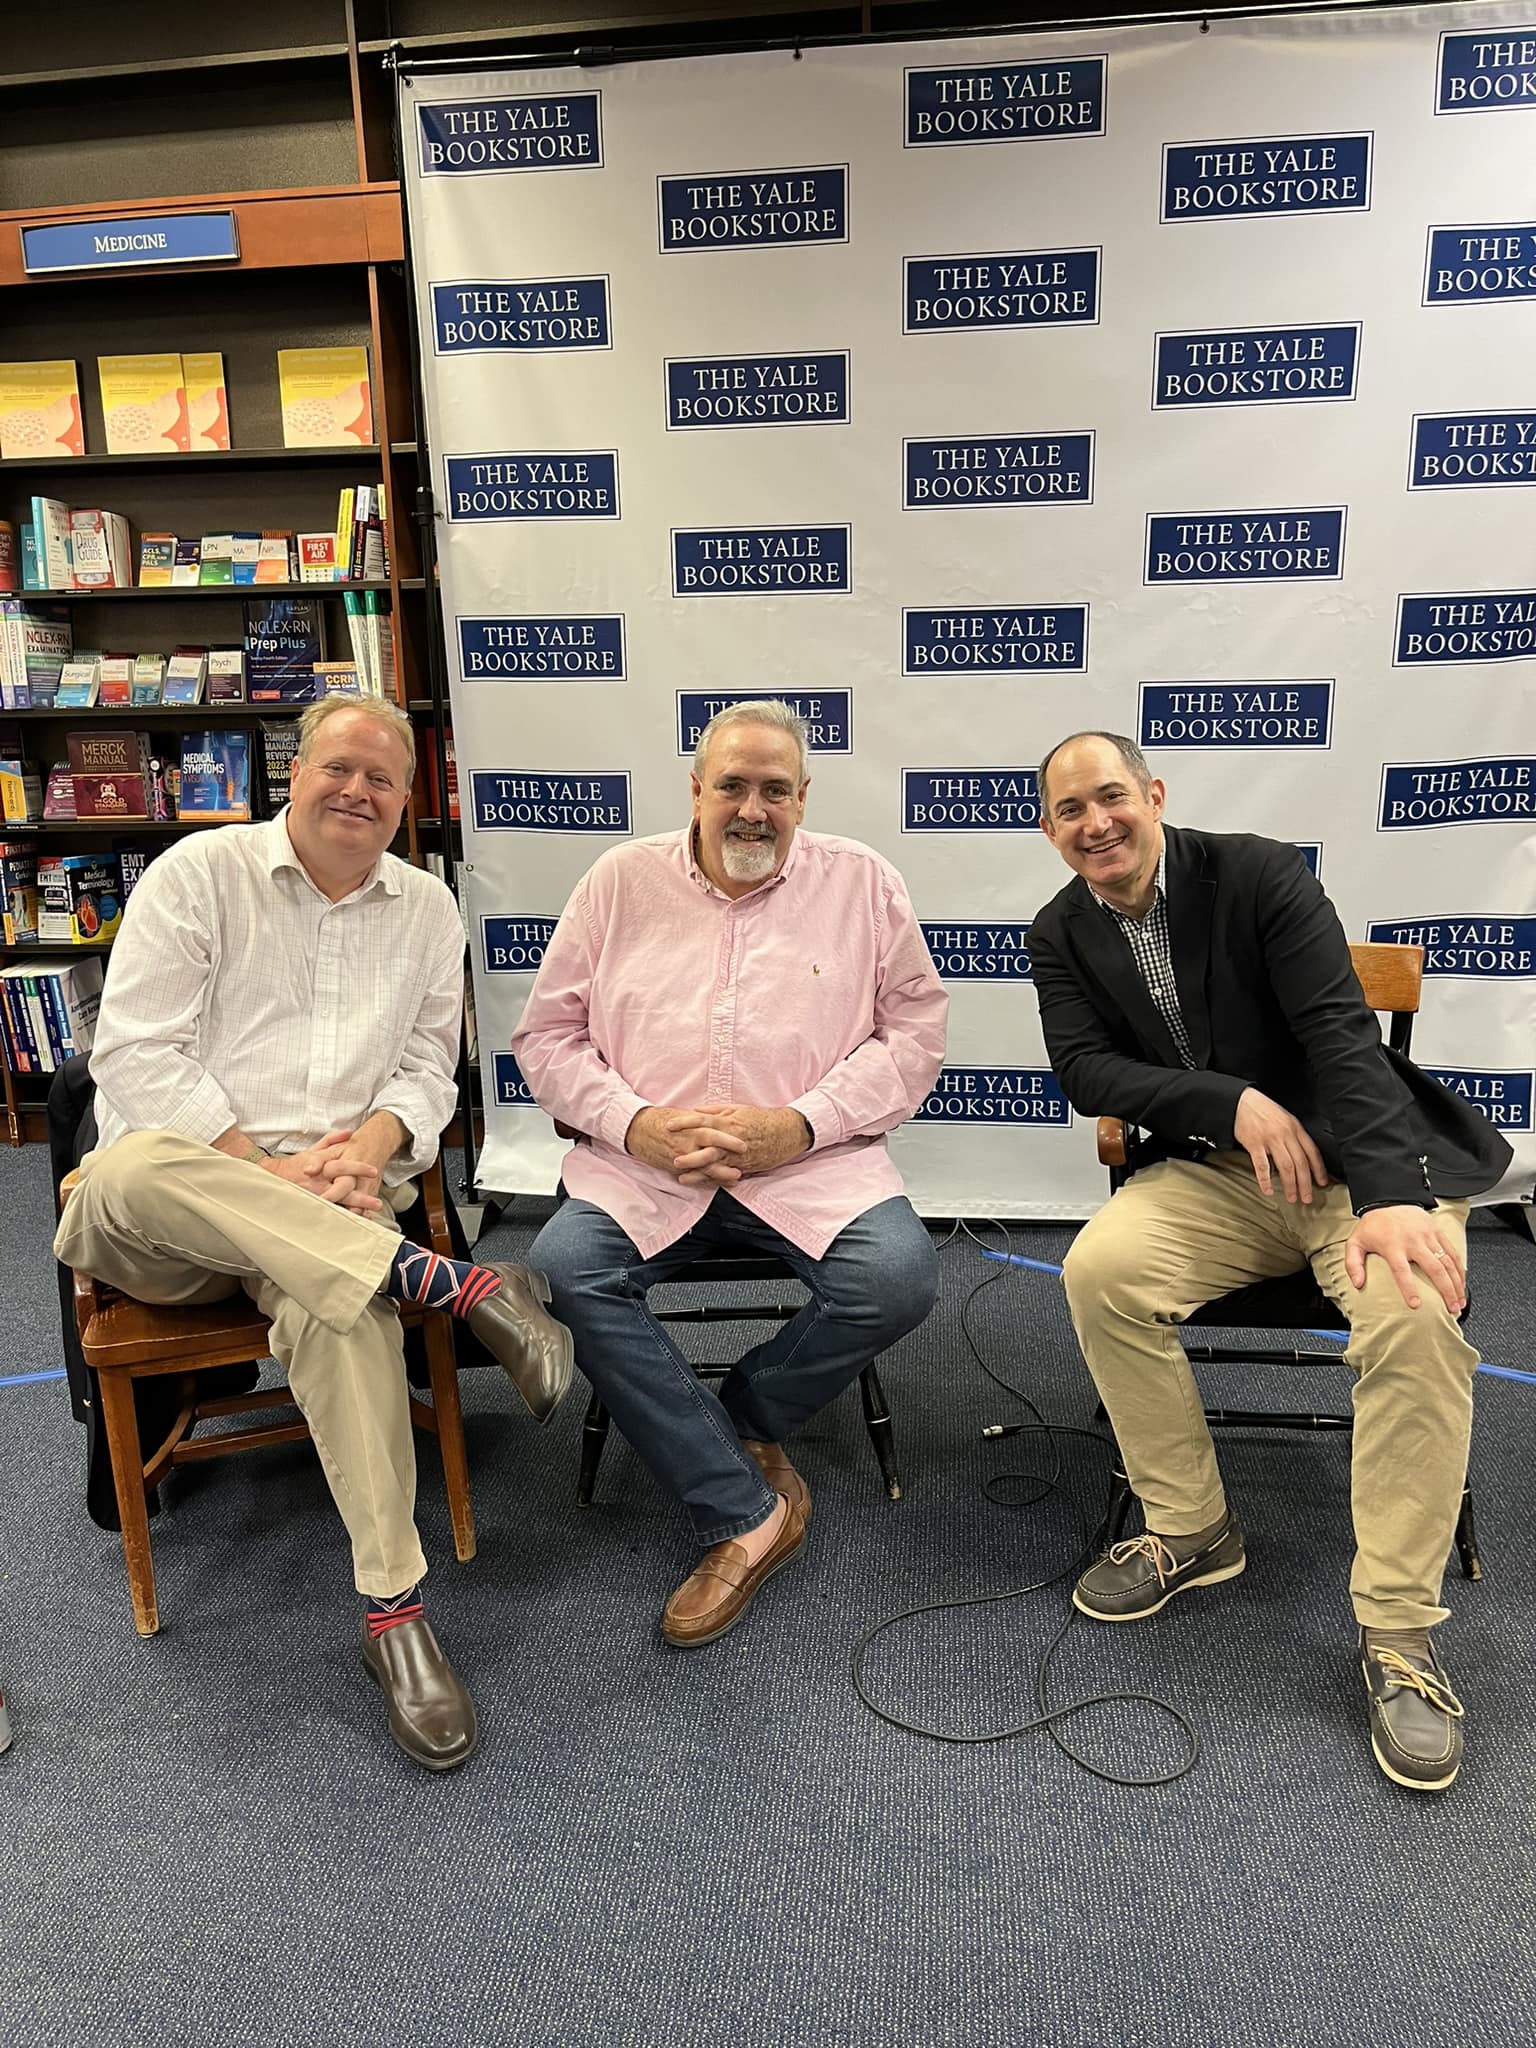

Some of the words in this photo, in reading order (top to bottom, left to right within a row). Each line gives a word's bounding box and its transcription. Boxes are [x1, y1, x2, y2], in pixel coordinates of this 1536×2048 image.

[1472, 41, 1536, 68] THE
[935, 77, 994, 103] THE
[1002, 71, 1072, 99] YALE
[444, 110, 498, 135] THE
[505, 105, 570, 131] YALE
[917, 101, 1093, 134] BOOKSTORE
[429, 134, 591, 166] BOOKSTORE
[1195, 152, 1256, 178] THE
[1264, 147, 1337, 174] YALE
[687, 185, 743, 210] THE
[750, 180, 816, 206] YALE
[1173, 176, 1358, 210] BOOKSTORE
[671, 209, 837, 241] BOOKSTORE
[94, 233, 168, 253] MEDICINE
[1459, 237, 1521, 262] THE
[934, 266, 991, 291] THE
[999, 262, 1067, 287] YALE
[456, 292, 509, 315] THE
[516, 289, 580, 313] YALE
[915, 291, 1088, 321] BOOKSTORE
[444, 317, 601, 344] BOOKSTORE
[1186, 342, 1246, 367] THE
[1254, 337, 1325, 363] YALE
[693, 368, 747, 391] THE
[754, 365, 818, 388] YALE
[1165, 366, 1344, 397] BOOKSTORE
[677, 392, 839, 419] BOOKSTORE
[1446, 424, 1507, 448] THE
[932, 447, 988, 471] THE
[995, 445, 1062, 468] YALE
[471, 463, 520, 486] THE
[525, 462, 589, 484] YALE
[914, 472, 1081, 498] BOOKSTORE
[457, 489, 609, 513] BOOKSTORE
[1177, 524, 1233, 546] THE
[1242, 520, 1311, 544] YALE
[203, 543, 218, 552] LPN
[307, 542, 328, 551] FIRST
[311, 551, 326, 559] AID
[699, 538, 751, 560] THE
[758, 536, 821, 558] YALE
[1156, 547, 1331, 574] BOOKSTORE
[683, 562, 840, 586] BOOKSTORE
[248, 620, 311, 634] NCLEX-RN
[1429, 604, 1486, 627] THE
[26, 631, 70, 646] NCLEX-RN
[482, 625, 529, 646] THE
[534, 626, 596, 646] YALE
[931, 618, 985, 639] THE
[992, 616, 1057, 637] YALE
[250, 637, 278, 652] Prep
[280, 636, 306, 649] Plus
[1406, 628, 1536, 655] BOOKSTO
[211, 658, 232, 668] Psych
[469, 651, 616, 672] BOOKSTORE
[913, 642, 1076, 665] BOOKSTORE
[325, 674, 355, 684] CCRN
[1168, 693, 1225, 714] THE
[1232, 692, 1300, 713] YALE
[263, 732, 297, 741] CLINICAL
[1149, 718, 1319, 740] BOOKSTORE
[81, 743, 126, 755] MERCK
[83, 755, 128, 765] MANUAL
[183, 752, 215, 763] MEDICAL
[265, 751, 294, 760] REVIEW
[182, 763, 225, 774] SYMPTOMS
[496, 779, 542, 800] THE
[545, 782, 603, 801] YALE
[929, 779, 982, 798] THE
[989, 778, 1040, 798] YAL
[1411, 771, 1462, 794] THE
[1468, 767, 1531, 789] YALE
[482, 803, 622, 825] BOOKSTORE
[912, 803, 1042, 823] BOOKSTO
[120, 854, 145, 867] EMT
[77, 879, 115, 890] Terminology
[84, 868, 106, 880] Medical
[122, 868, 144, 881] EXA
[928, 930, 979, 949] THE
[986, 931, 1028, 950] YAL
[1392, 927, 1441, 945] THE
[1447, 925, 1515, 945] YALE
[932, 954, 1033, 973] OOKSTO
[984, 1076, 1044, 1095] YALE
